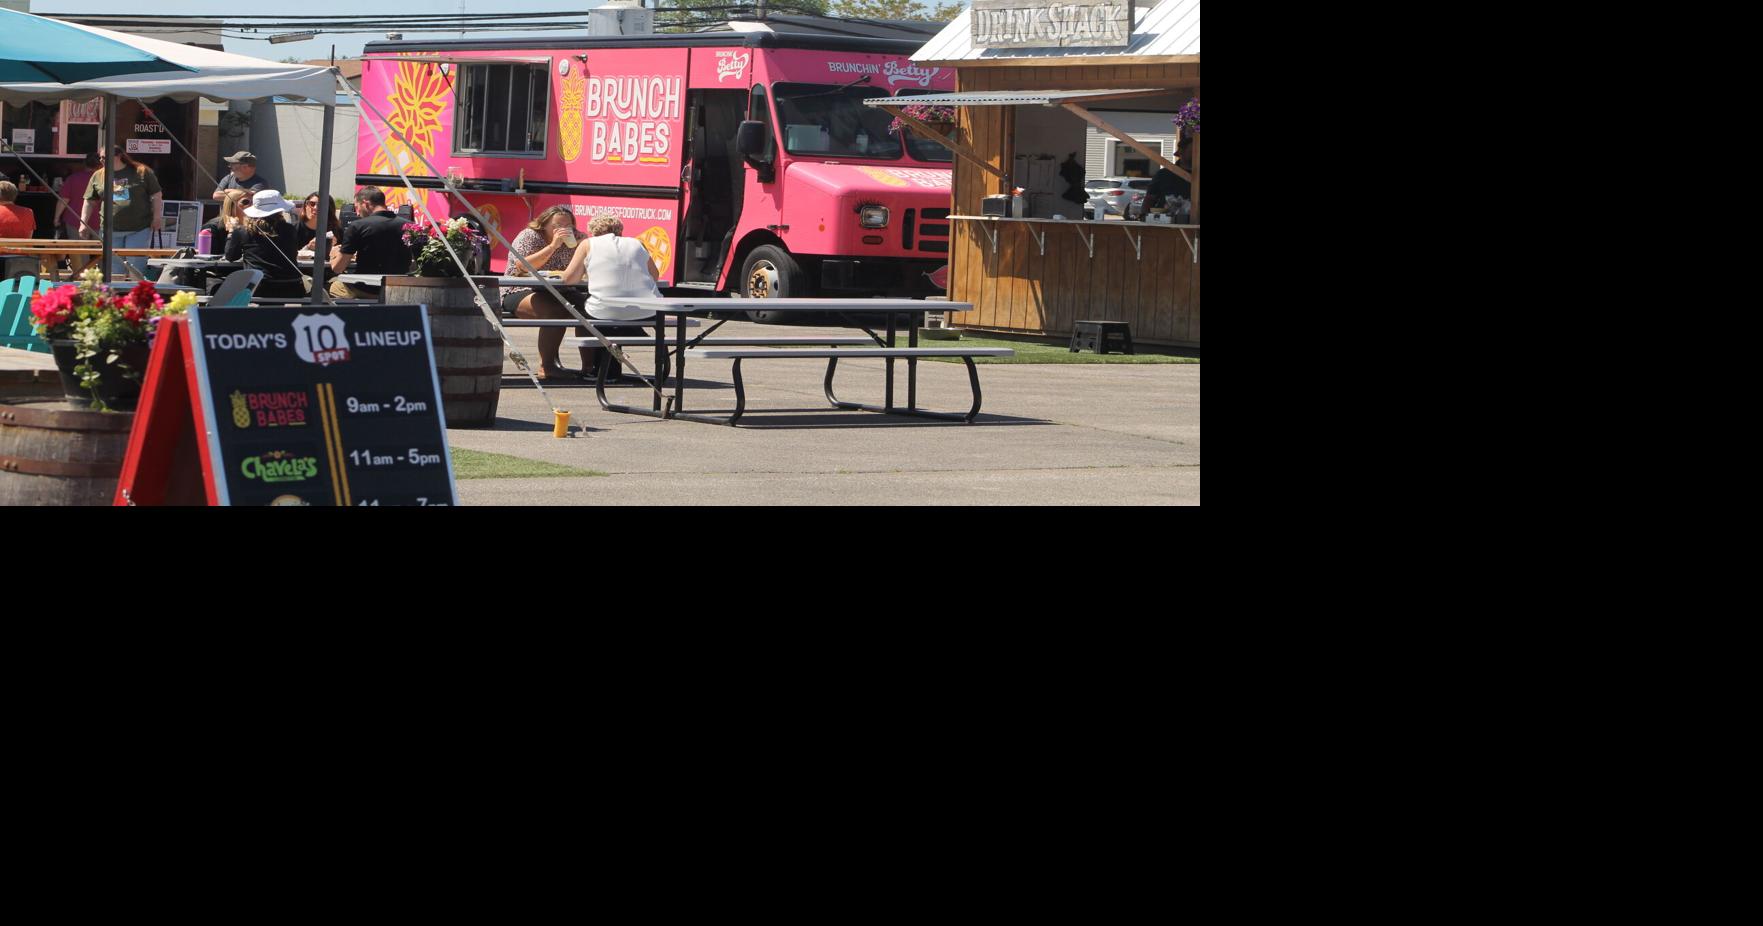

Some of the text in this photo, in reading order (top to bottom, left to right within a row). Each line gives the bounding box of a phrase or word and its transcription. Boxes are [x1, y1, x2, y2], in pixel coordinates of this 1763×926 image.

[977, 3, 1122, 43] DRINK SHACK
[717, 51, 749, 82] Betty
[828, 60, 940, 87] BRUNCHIN' Betty
[587, 78, 680, 119] BRUNCH
[592, 121, 670, 161] BABES
[205, 325, 421, 352] TODAY'S 10 LINEUP
[318, 350, 347, 362] SPOT
[248, 392, 308, 410] BRUNCH
[346, 396, 380, 413] 9am
[394, 396, 427, 414] 2pm
[256, 409, 306, 428] BABES
[350, 449, 394, 466] 11am
[408, 448, 440, 467] 5pm
